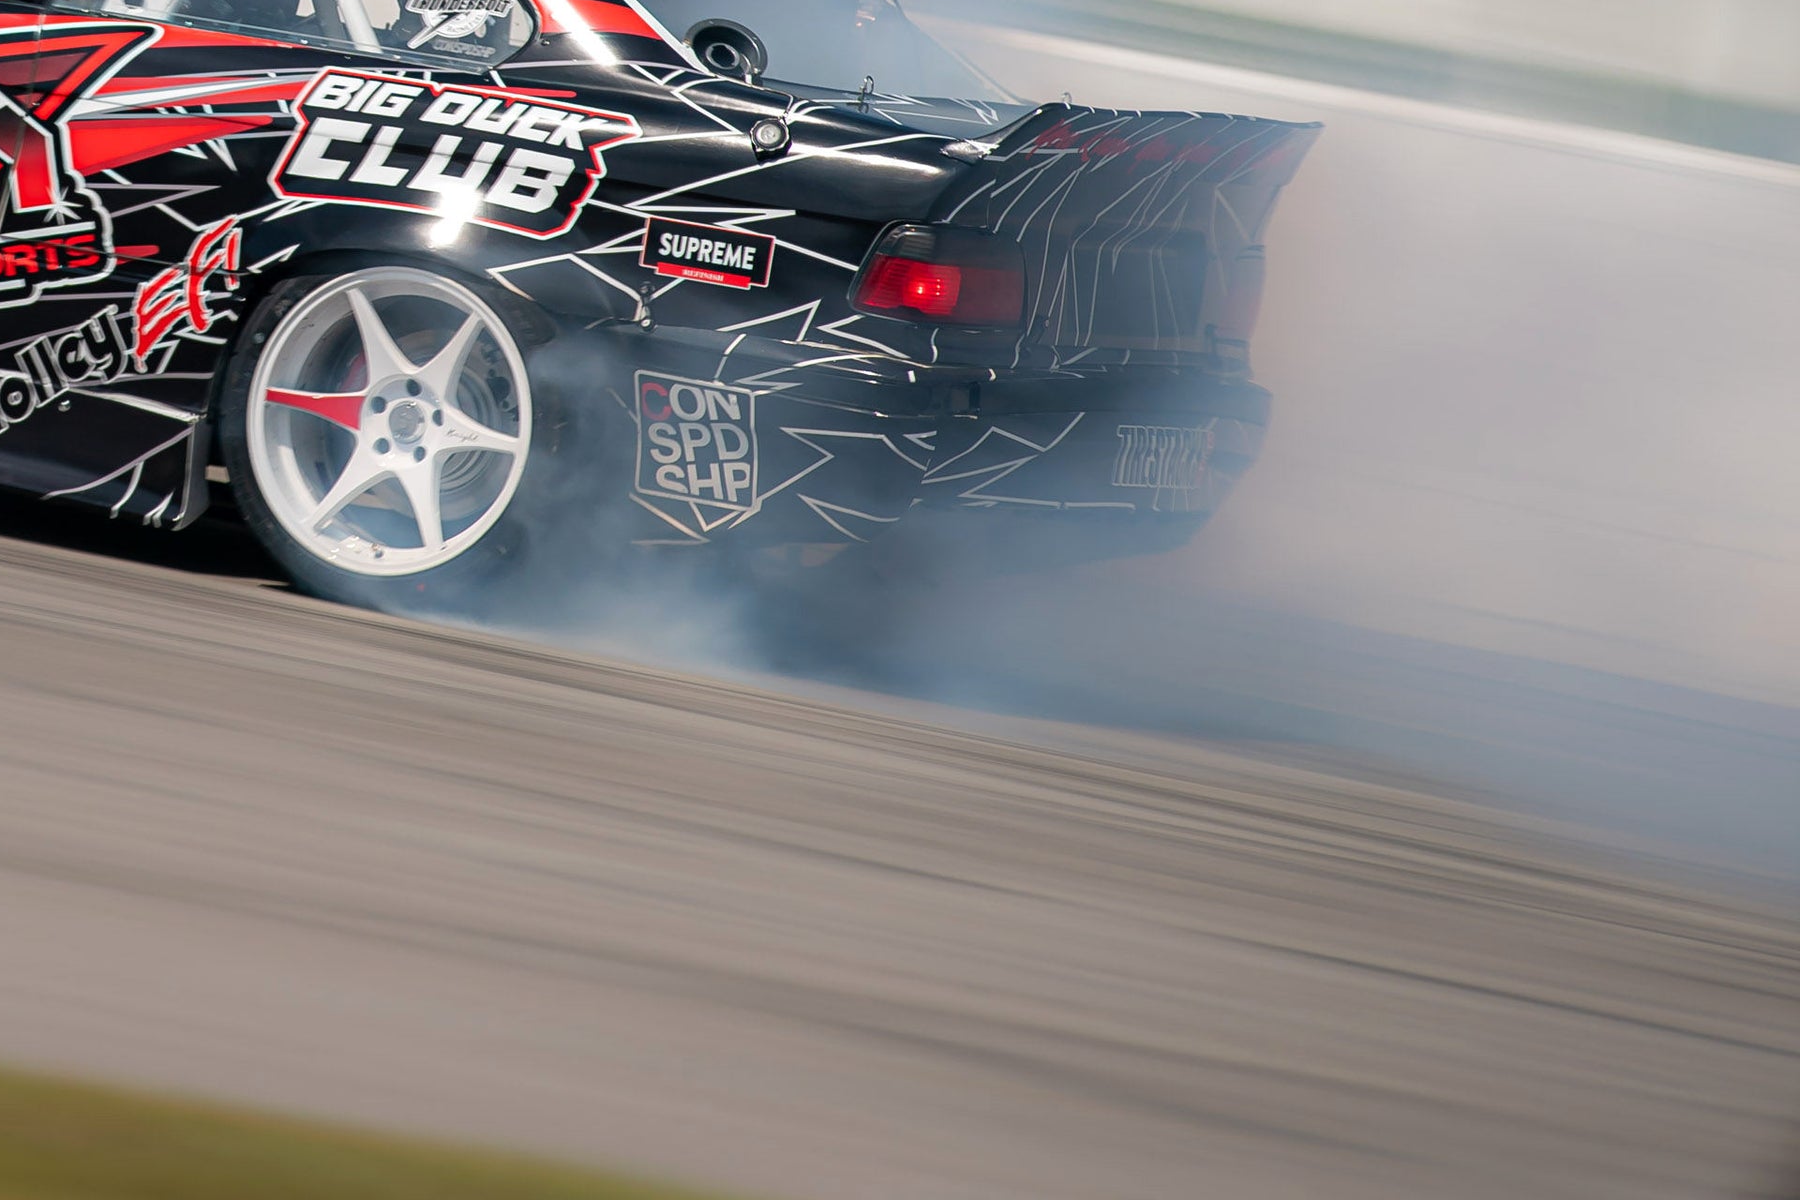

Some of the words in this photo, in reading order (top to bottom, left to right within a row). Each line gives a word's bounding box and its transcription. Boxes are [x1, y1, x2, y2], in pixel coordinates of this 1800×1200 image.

[303, 75, 425, 117] BIG
[418, 93, 611, 151] DUCK
[285, 116, 576, 214] CLUB
[658, 232, 757, 270] SUPREME
[641, 382, 742, 422] CON
[647, 422, 750, 465] SPD
[655, 462, 751, 502] SHP
